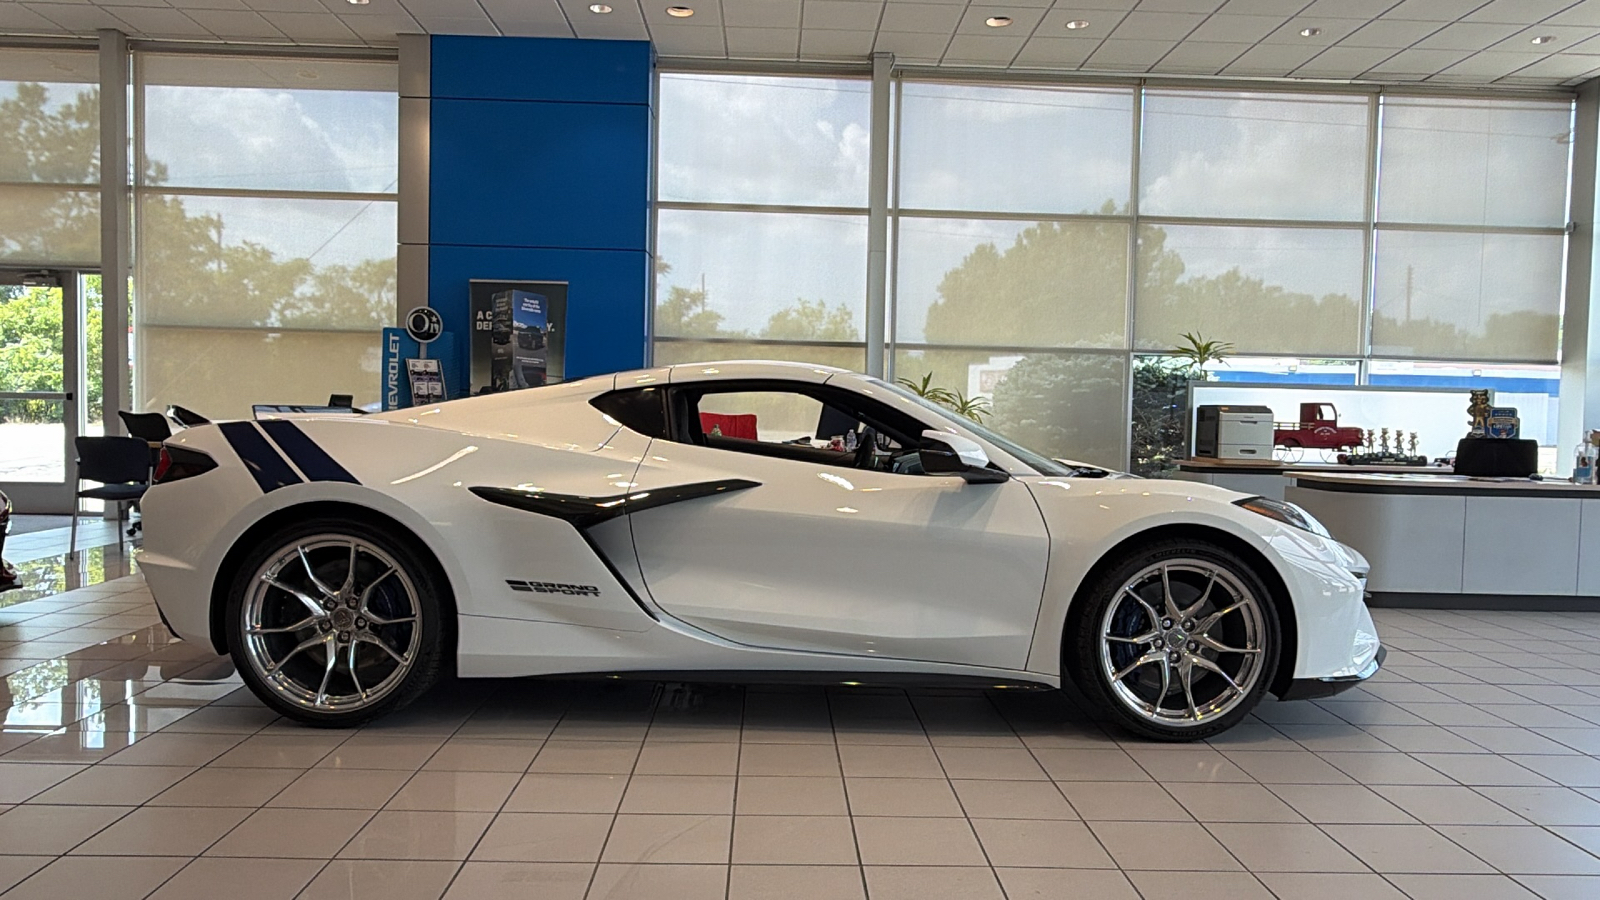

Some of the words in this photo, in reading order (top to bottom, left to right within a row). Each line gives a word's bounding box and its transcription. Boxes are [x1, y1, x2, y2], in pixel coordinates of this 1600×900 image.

[476, 310, 484, 320] A
[528, 581, 599, 592] GRAND
[534, 587, 602, 597] SPORT
